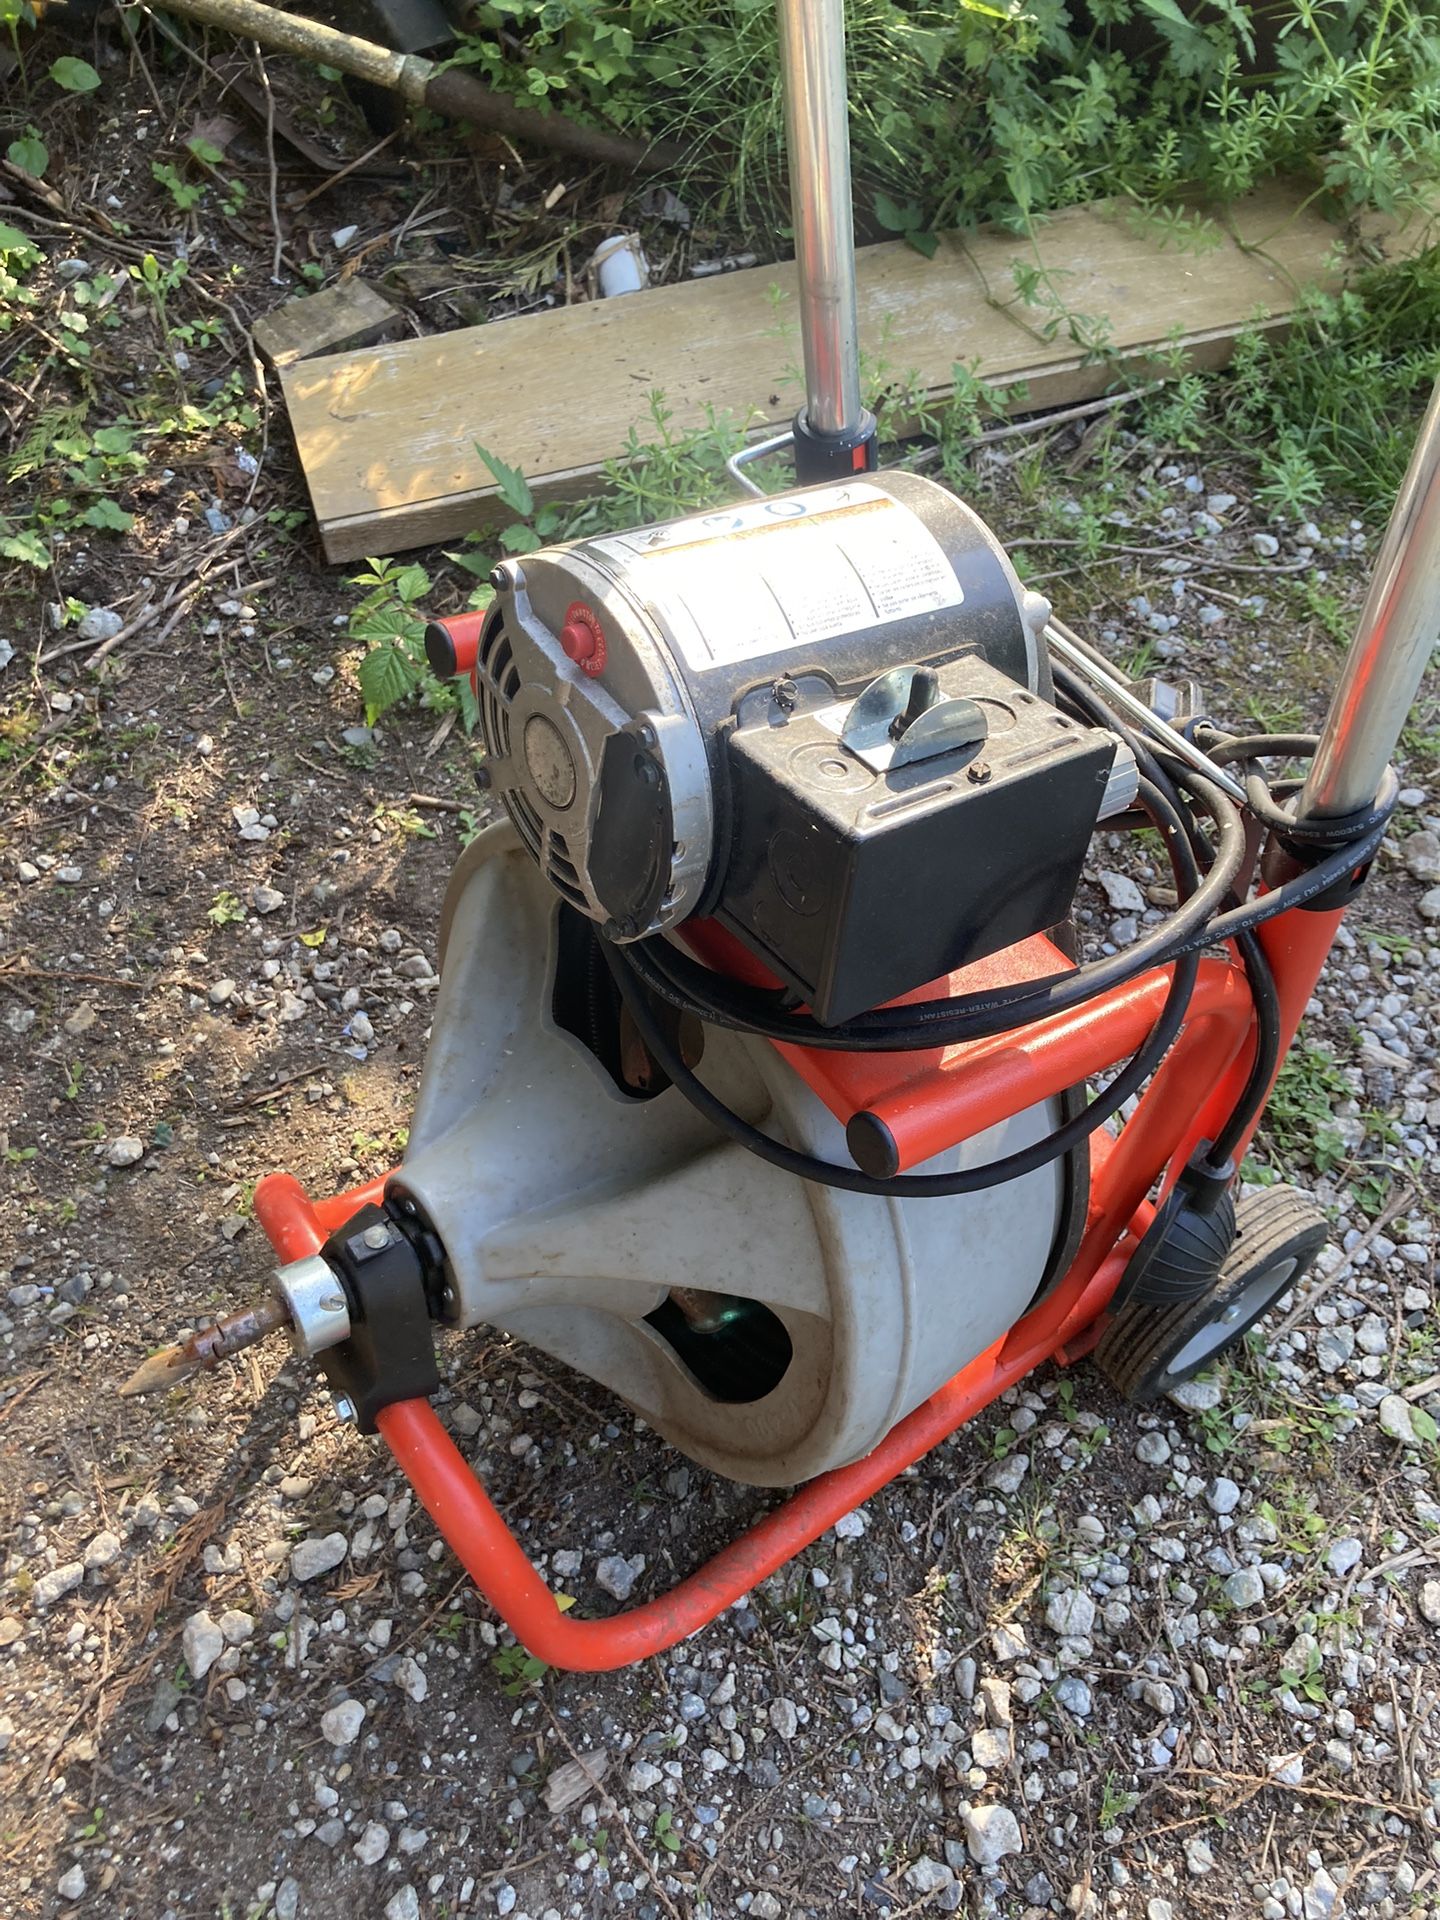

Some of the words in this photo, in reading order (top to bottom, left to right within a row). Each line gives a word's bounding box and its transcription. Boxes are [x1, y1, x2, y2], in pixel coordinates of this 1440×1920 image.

[1281, 894, 1301, 908] 300V
[1240, 918, 1253, 927] TO
[1192, 935, 1212, 947] CSA
[918, 1000, 999, 1021] WATER-RESISTANT
